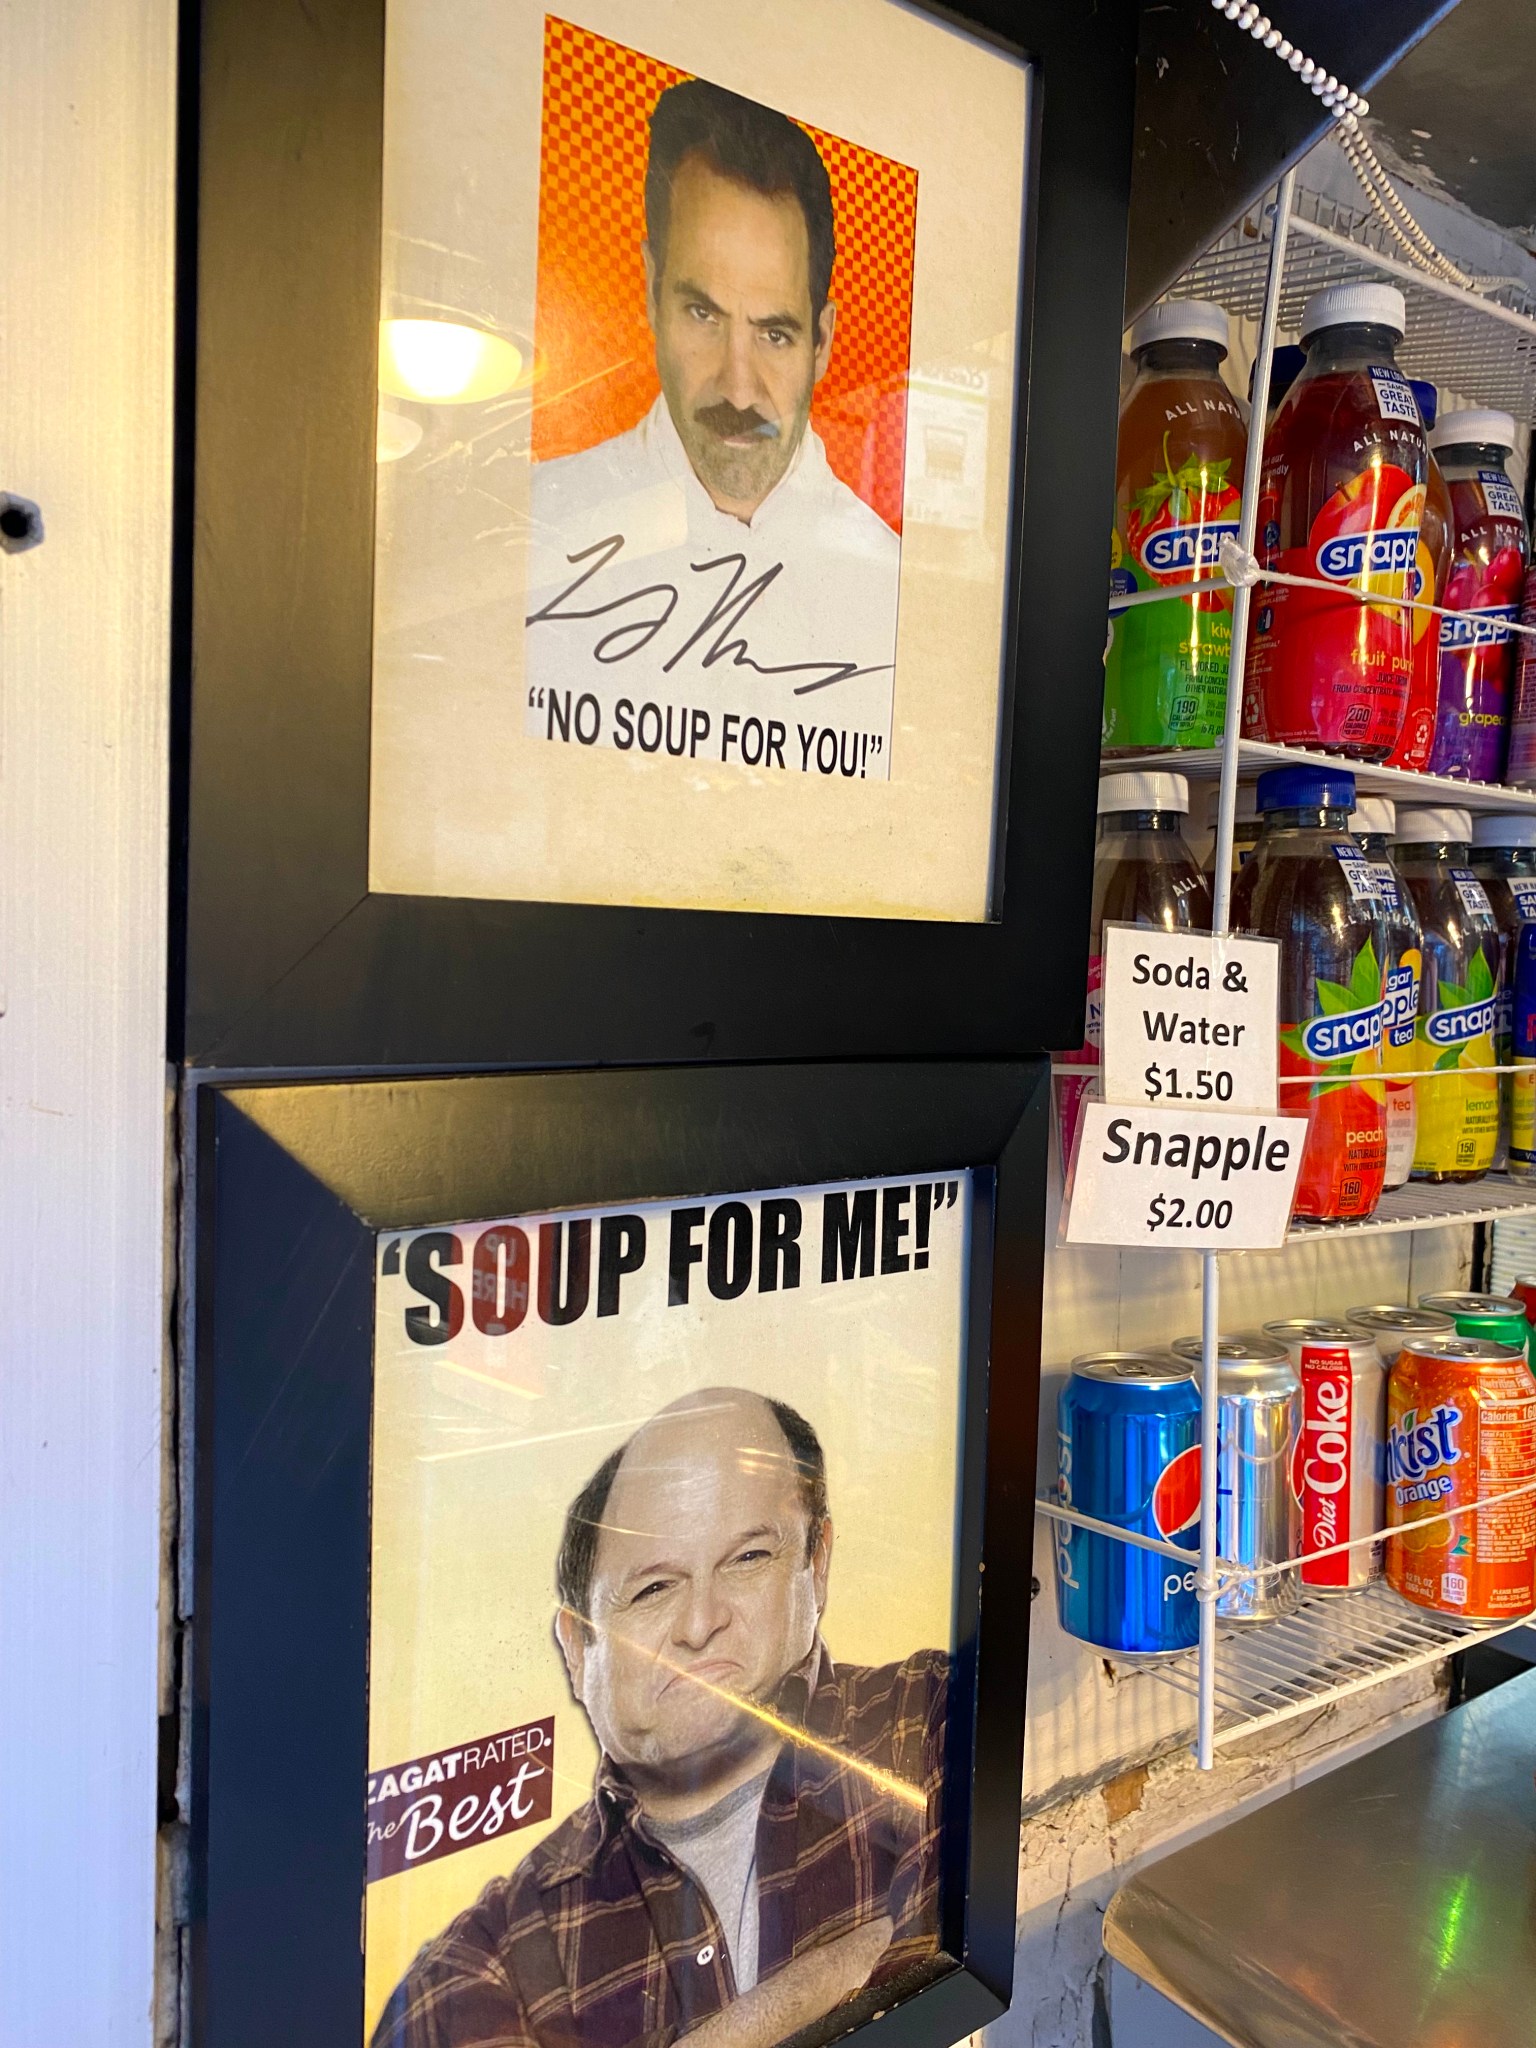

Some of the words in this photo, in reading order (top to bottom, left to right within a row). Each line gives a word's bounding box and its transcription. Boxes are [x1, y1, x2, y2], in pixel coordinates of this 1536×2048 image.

[1372, 367, 1389, 378] NEW
[1380, 389, 1414, 405] GREAT
[1165, 402, 1197, 421] ALL
[1383, 401, 1417, 419] TASTE
[1354, 432, 1382, 452] ALL
[1488, 490, 1517, 502] GREAT
[1491, 500, 1521, 515] TASTE
[1461, 526, 1488, 543] ALL
[1180, 660, 1219, 674] FLVORED
[1177, 700, 1196, 714] 190
[1348, 707, 1371, 723] 200
[612, 698, 711, 759] SOUP
[720, 714, 787, 769] FOR
[1172, 877, 1197, 898] ALL
[1132, 954, 1210, 990] Soda
[1222, 961, 1249, 993] &
[1387, 971, 1411, 991] gar
[1143, 1010, 1245, 1047] Water
[1314, 1014, 1382, 1052] snap
[1394, 1028, 1413, 1045] tea
[1144, 1062, 1233, 1102] $1.50
[1392, 1098, 1411, 1111] tea
[1346, 1126, 1384, 1147] peach
[1102, 1117, 1290, 1179] Snapple
[1460, 1142, 1474, 1153] 150
[1344, 1181, 1360, 1195] 160
[1146, 1192, 1233, 1232] $2.00
[668, 1198, 803, 1307] FOR
[1481, 1411, 1517, 1421] Calories
[1304, 1380, 1349, 1494] Coke
[1396, 1476, 1453, 1506] Orange
[1313, 1498, 1338, 1548] Diet
[1445, 1576, 1464, 1590] 160
[397, 1761, 546, 1861] Best
